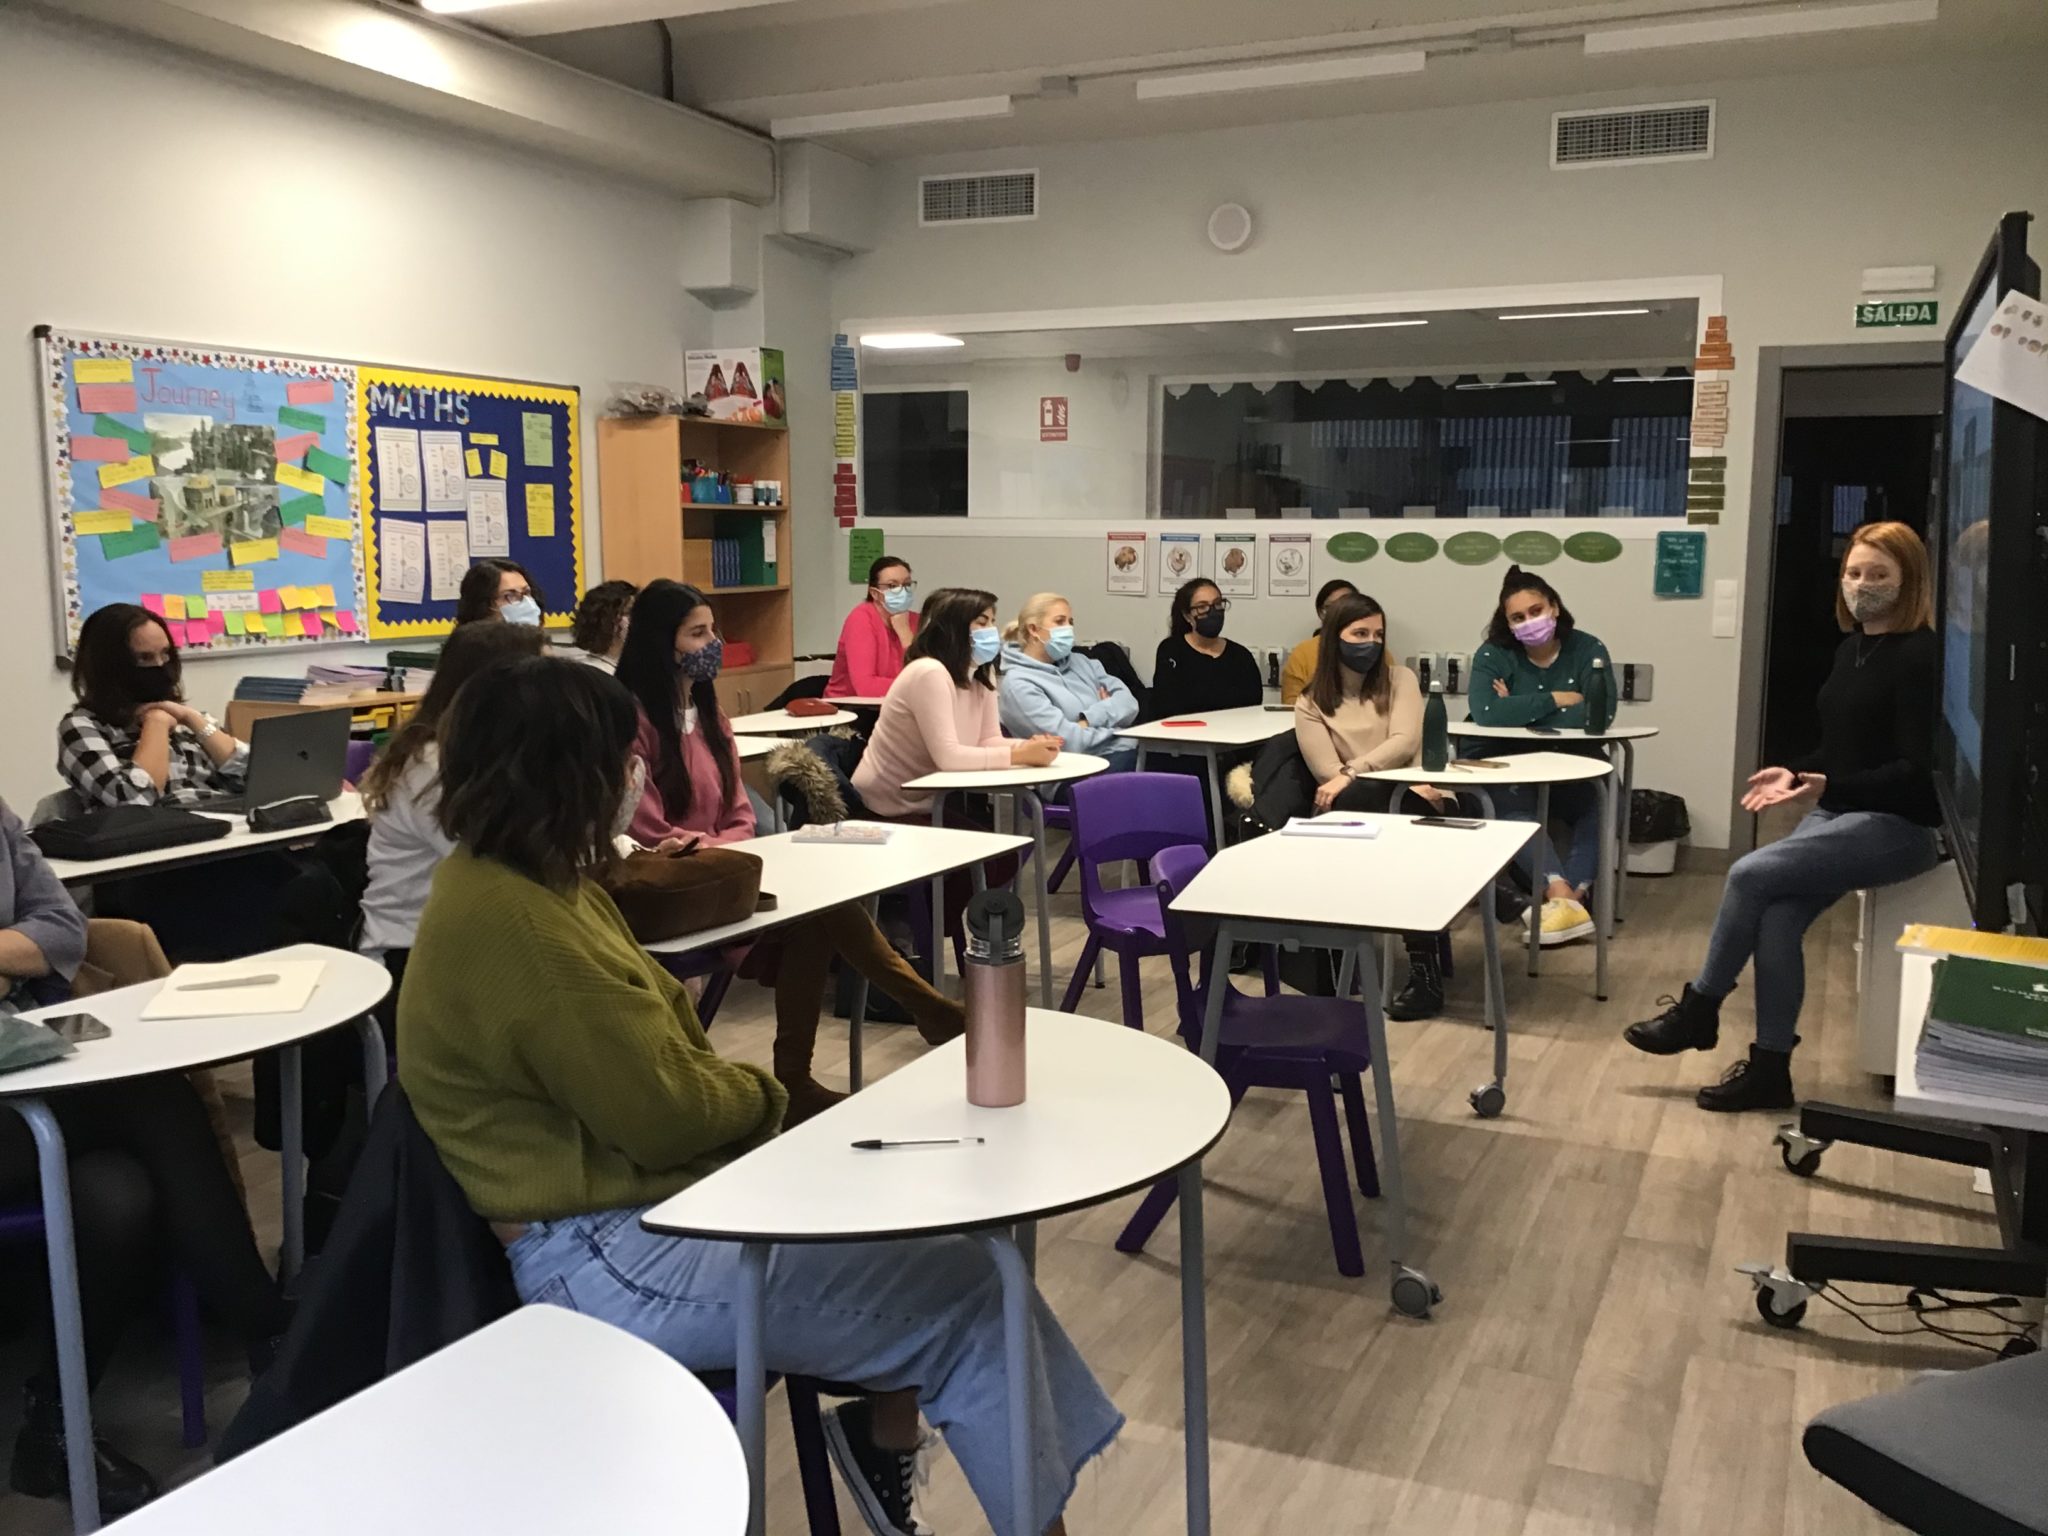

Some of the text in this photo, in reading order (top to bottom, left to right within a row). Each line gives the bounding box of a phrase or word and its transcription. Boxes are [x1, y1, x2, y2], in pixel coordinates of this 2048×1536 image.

[1862, 304, 1931, 323] SALIDA
[140, 367, 236, 421] Journey
[369, 383, 470, 425] MATHS
